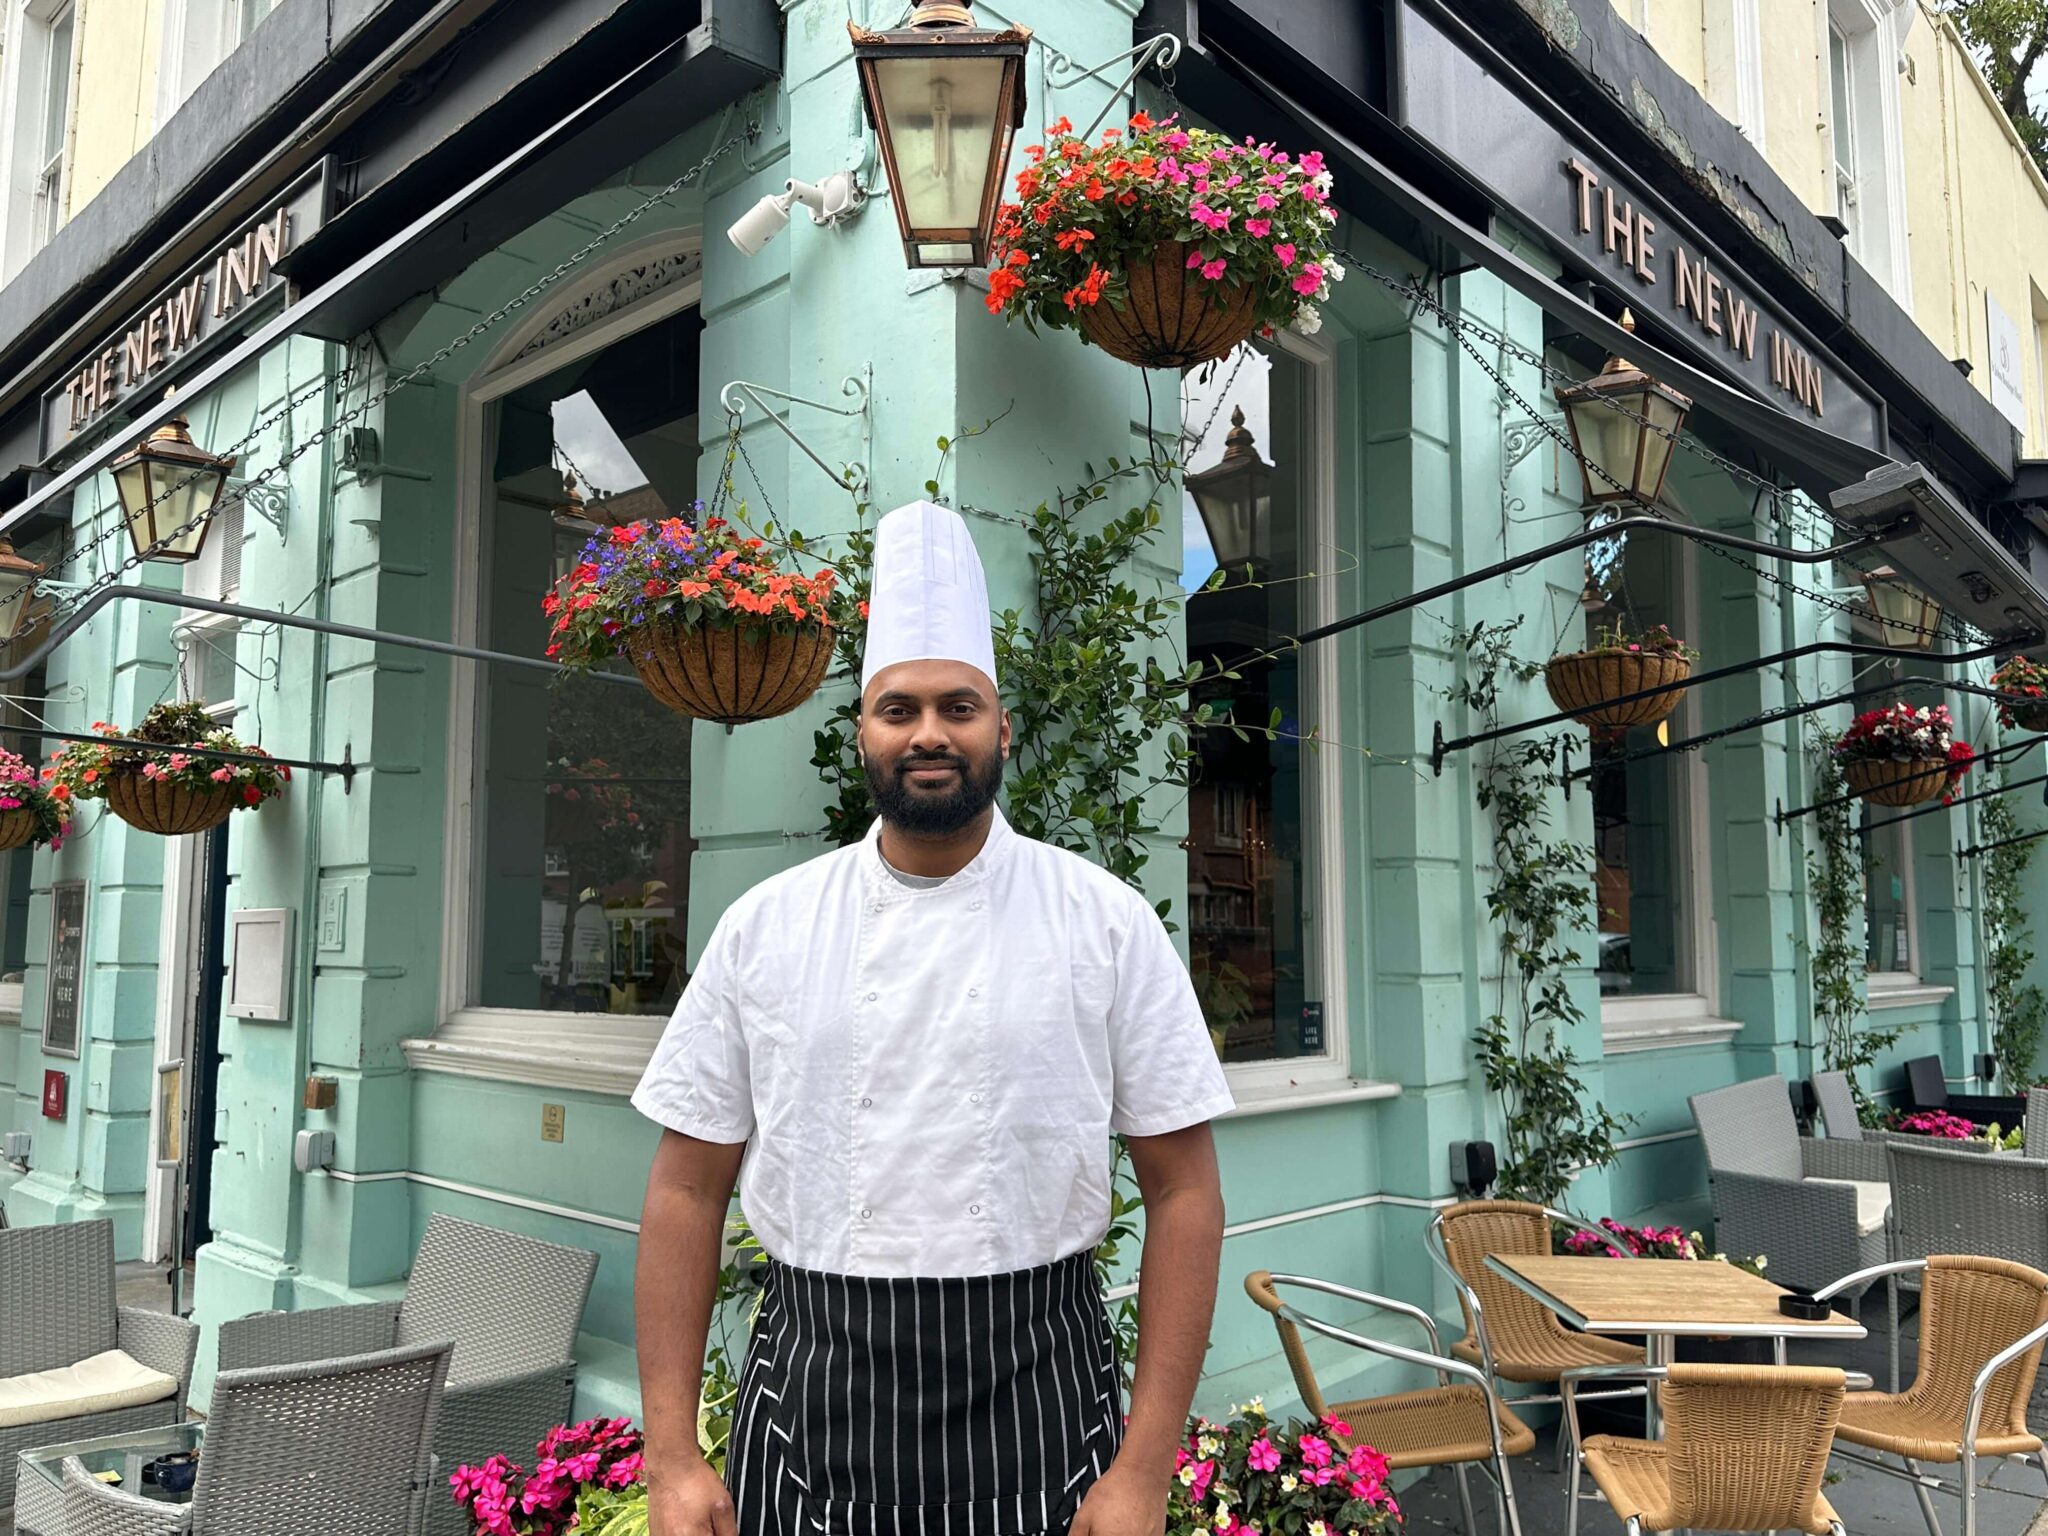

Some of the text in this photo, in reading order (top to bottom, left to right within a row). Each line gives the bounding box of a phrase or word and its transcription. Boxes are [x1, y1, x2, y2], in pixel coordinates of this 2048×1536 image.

[66, 207, 289, 430] THE NEW INN
[1568, 157, 1823, 417] THE NEW INN
[57, 987, 72, 1002] HERE
[59, 965, 73, 980] LIVE
